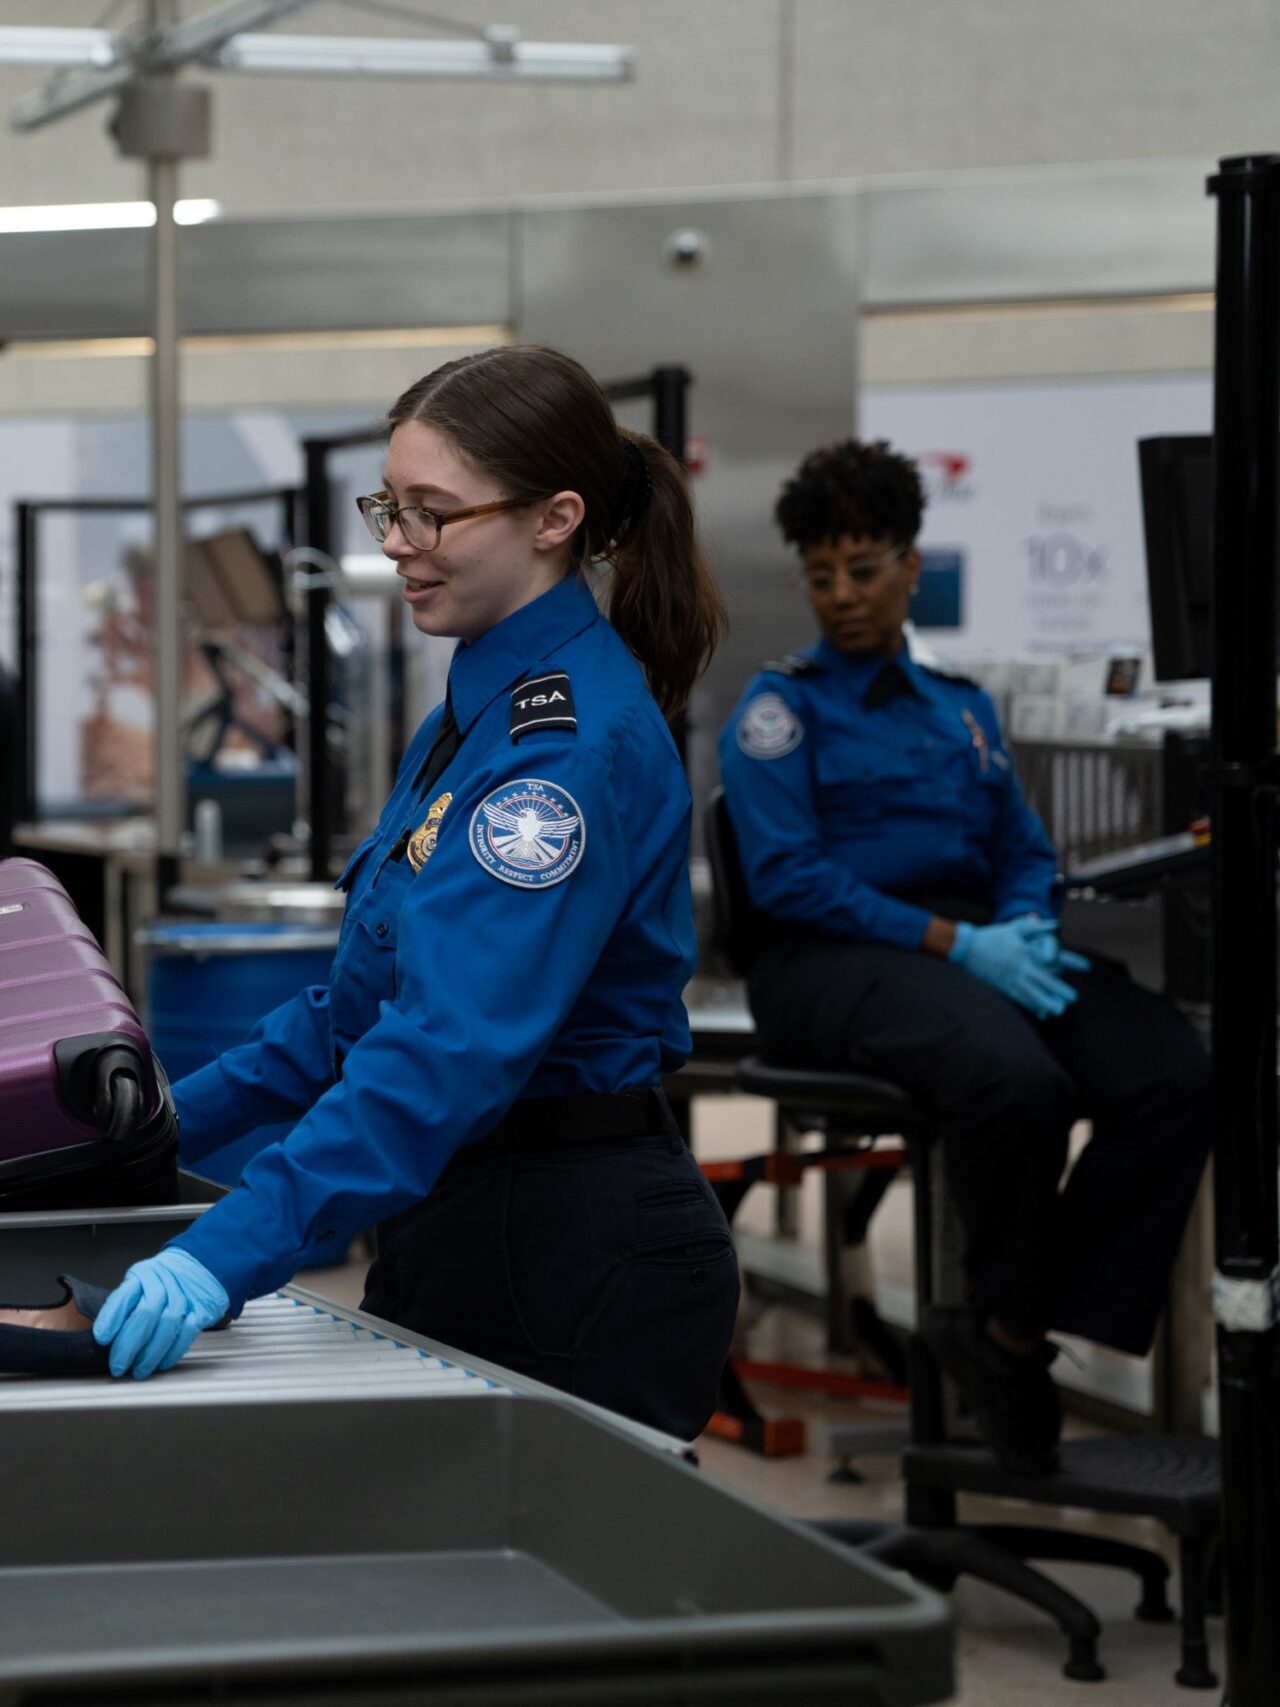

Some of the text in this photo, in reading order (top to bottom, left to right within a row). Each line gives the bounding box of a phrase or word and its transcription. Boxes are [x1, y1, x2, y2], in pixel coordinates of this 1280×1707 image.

[515, 690, 567, 710] TSA
[526, 782, 544, 792] TSA
[476, 824, 579, 881] INTEGRITY RESPECT COMMITMENT
